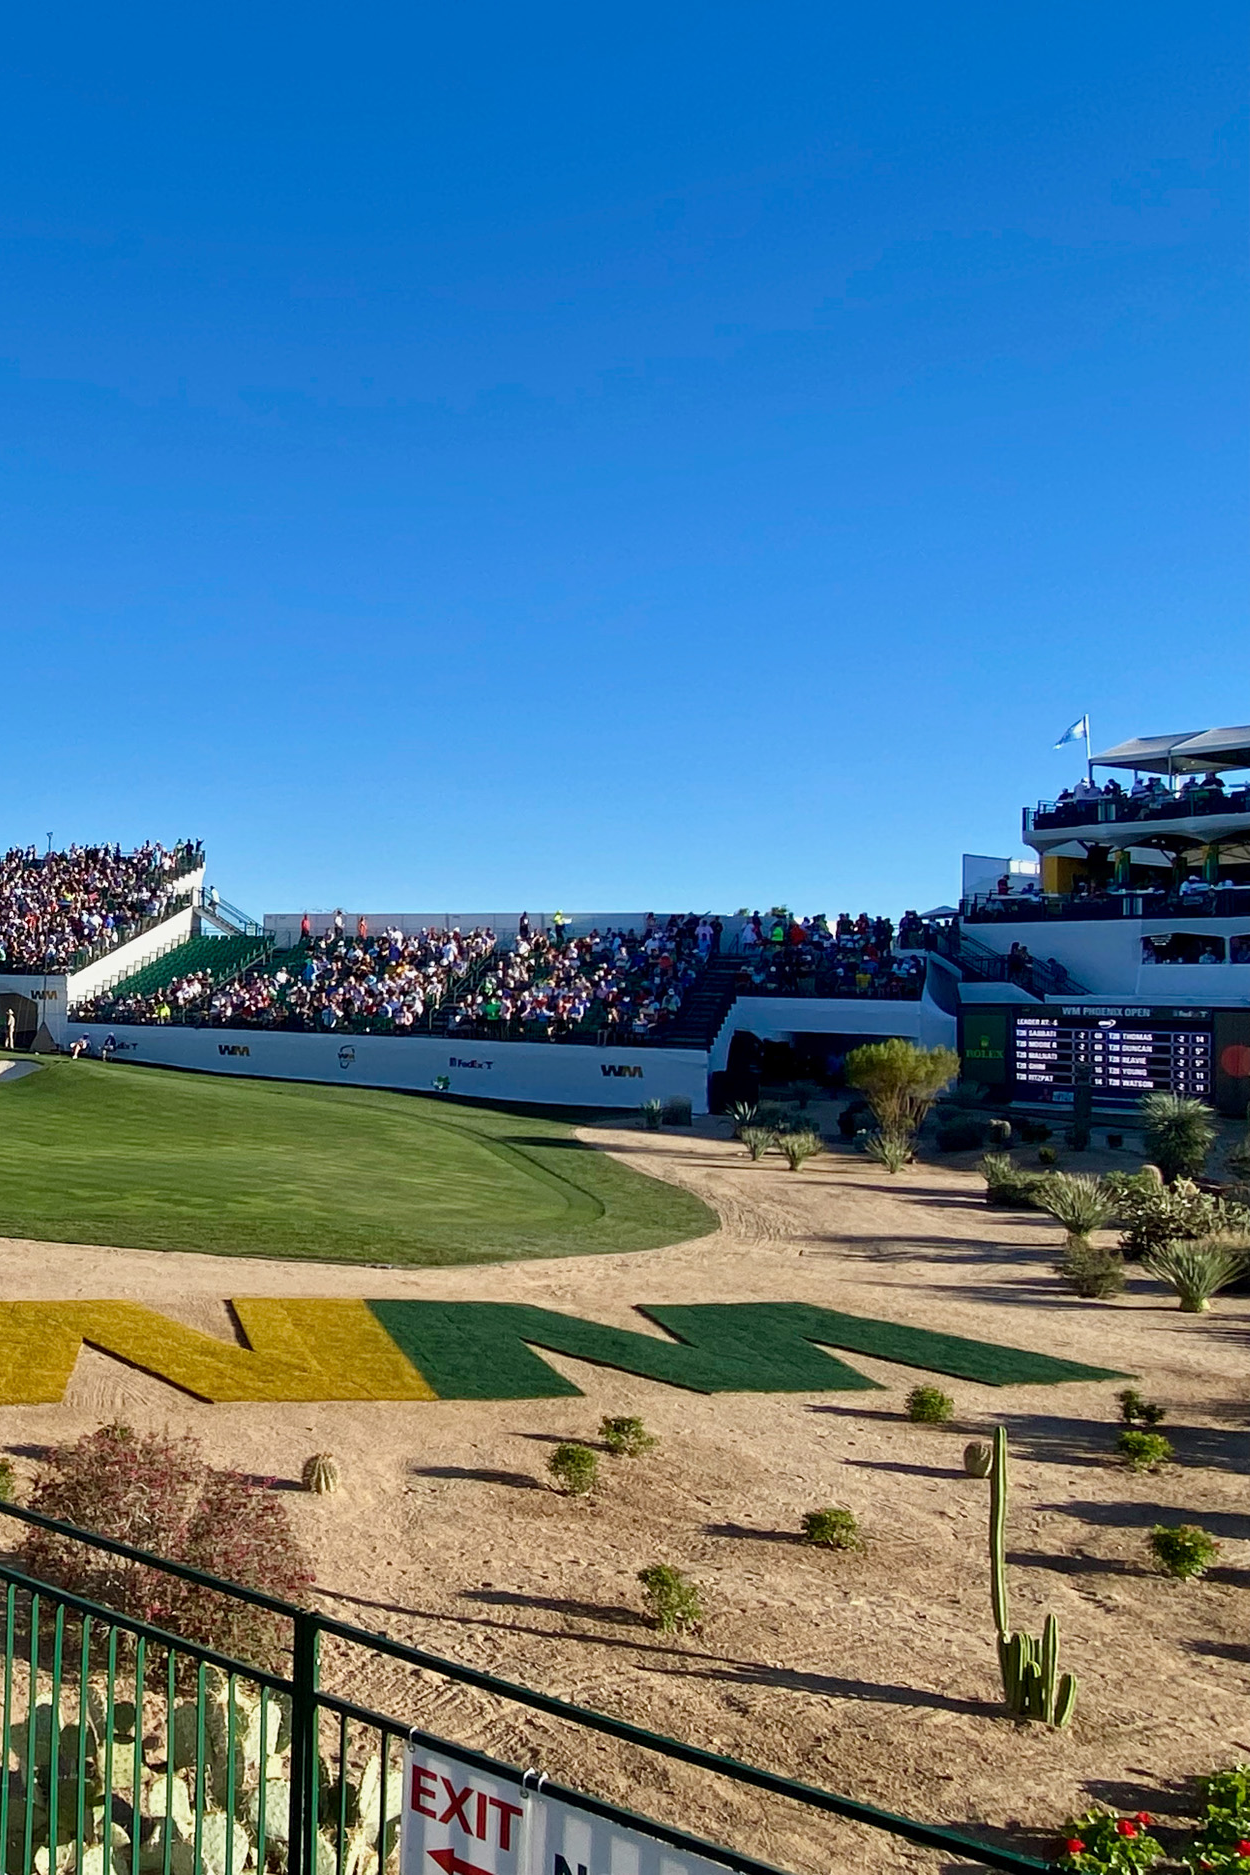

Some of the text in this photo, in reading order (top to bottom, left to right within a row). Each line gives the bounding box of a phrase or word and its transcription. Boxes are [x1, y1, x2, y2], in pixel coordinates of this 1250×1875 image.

[30, 990, 58, 1000] WM
[218, 1044, 250, 1057] WM
[966, 1048, 1004, 1059] ROLEX
[600, 1064, 644, 1078] WM
[410, 1764, 523, 1851] EXIT
